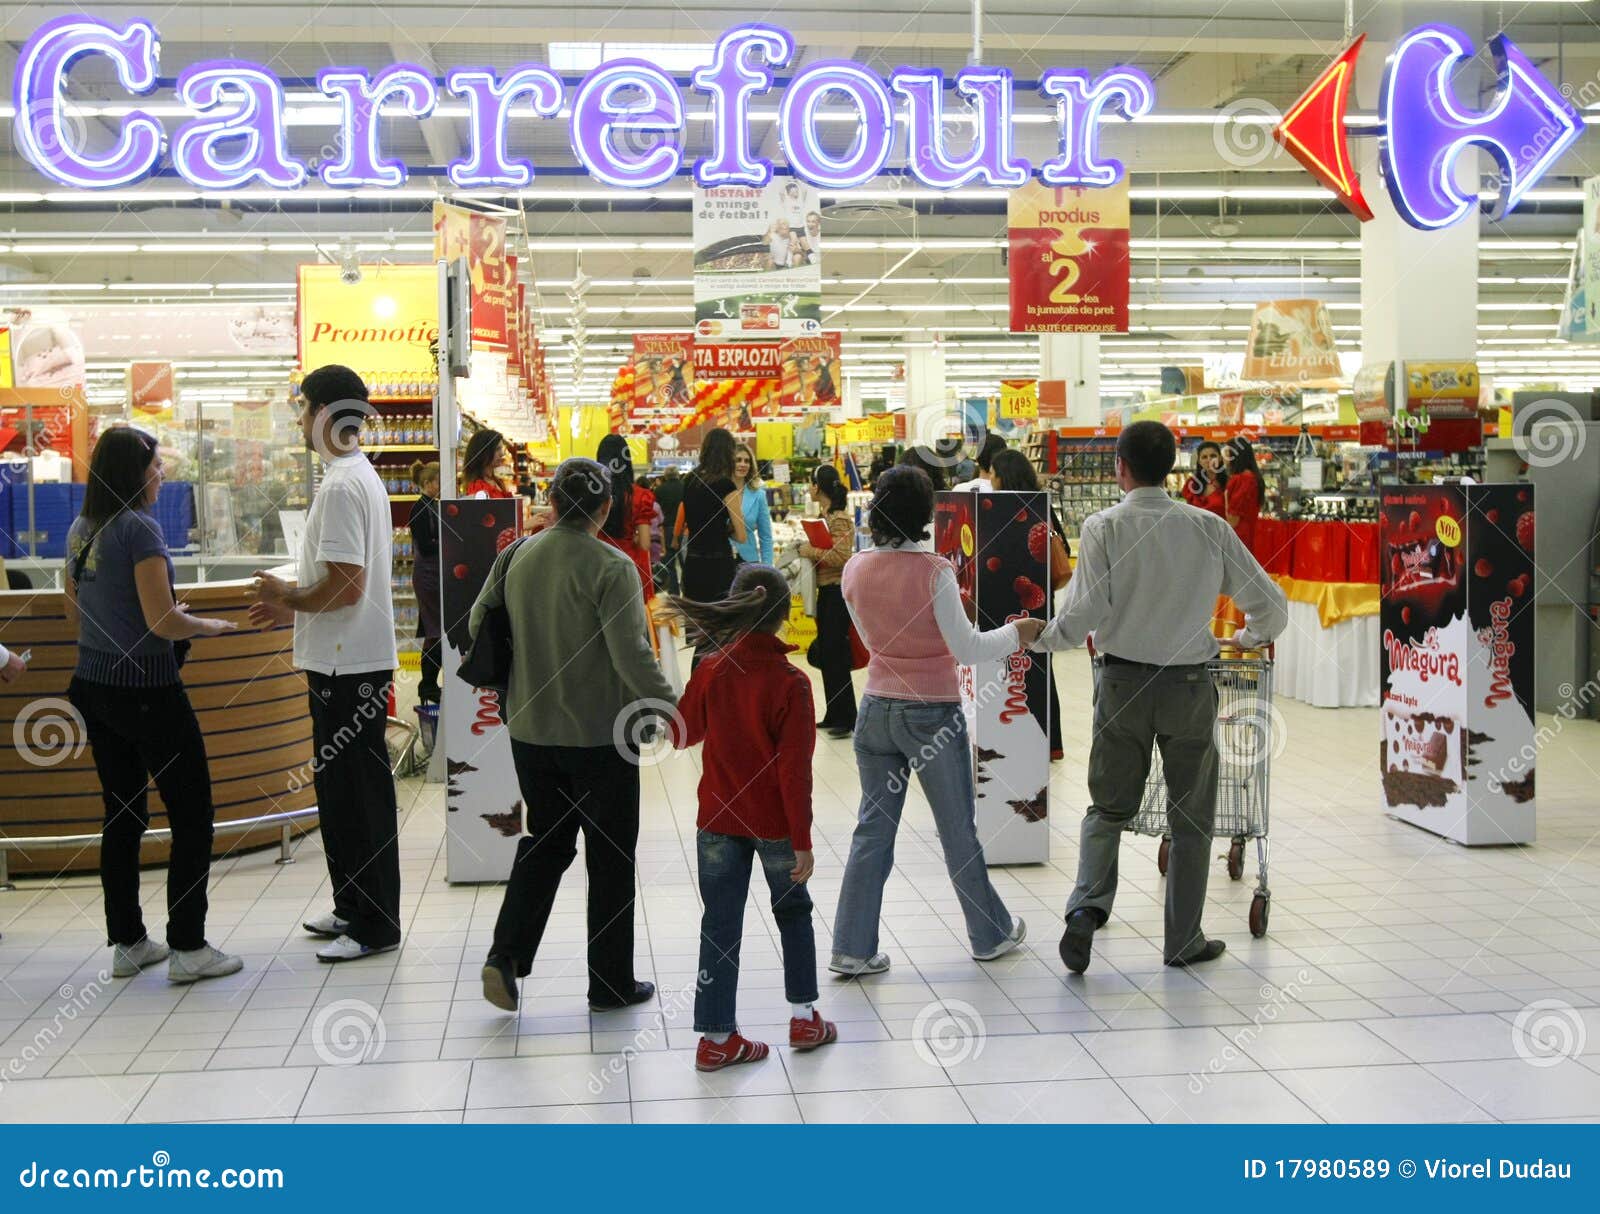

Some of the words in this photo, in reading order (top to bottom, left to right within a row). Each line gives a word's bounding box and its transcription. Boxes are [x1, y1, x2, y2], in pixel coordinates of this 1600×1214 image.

[13, 14, 1155, 191] Carrefour
[704, 189, 763, 198] INSTANT
[716, 200, 759, 210] minge
[699, 210, 715, 219] de
[719, 210, 760, 220] fotbal
[1039, 207, 1100, 226] produs
[1041, 251, 1053, 263] al
[1027, 305, 1037, 314] la
[1036, 305, 1079, 316] jumatate
[1080, 305, 1093, 315] de
[1093, 305, 1115, 316] pret
[1025, 324, 1037, 333] LA
[1062, 324, 1074, 333] DE
[1075, 324, 1117, 333] PRODUSE
[1439, 519, 1458, 541] NOU
[1383, 628, 1463, 688] Magura
